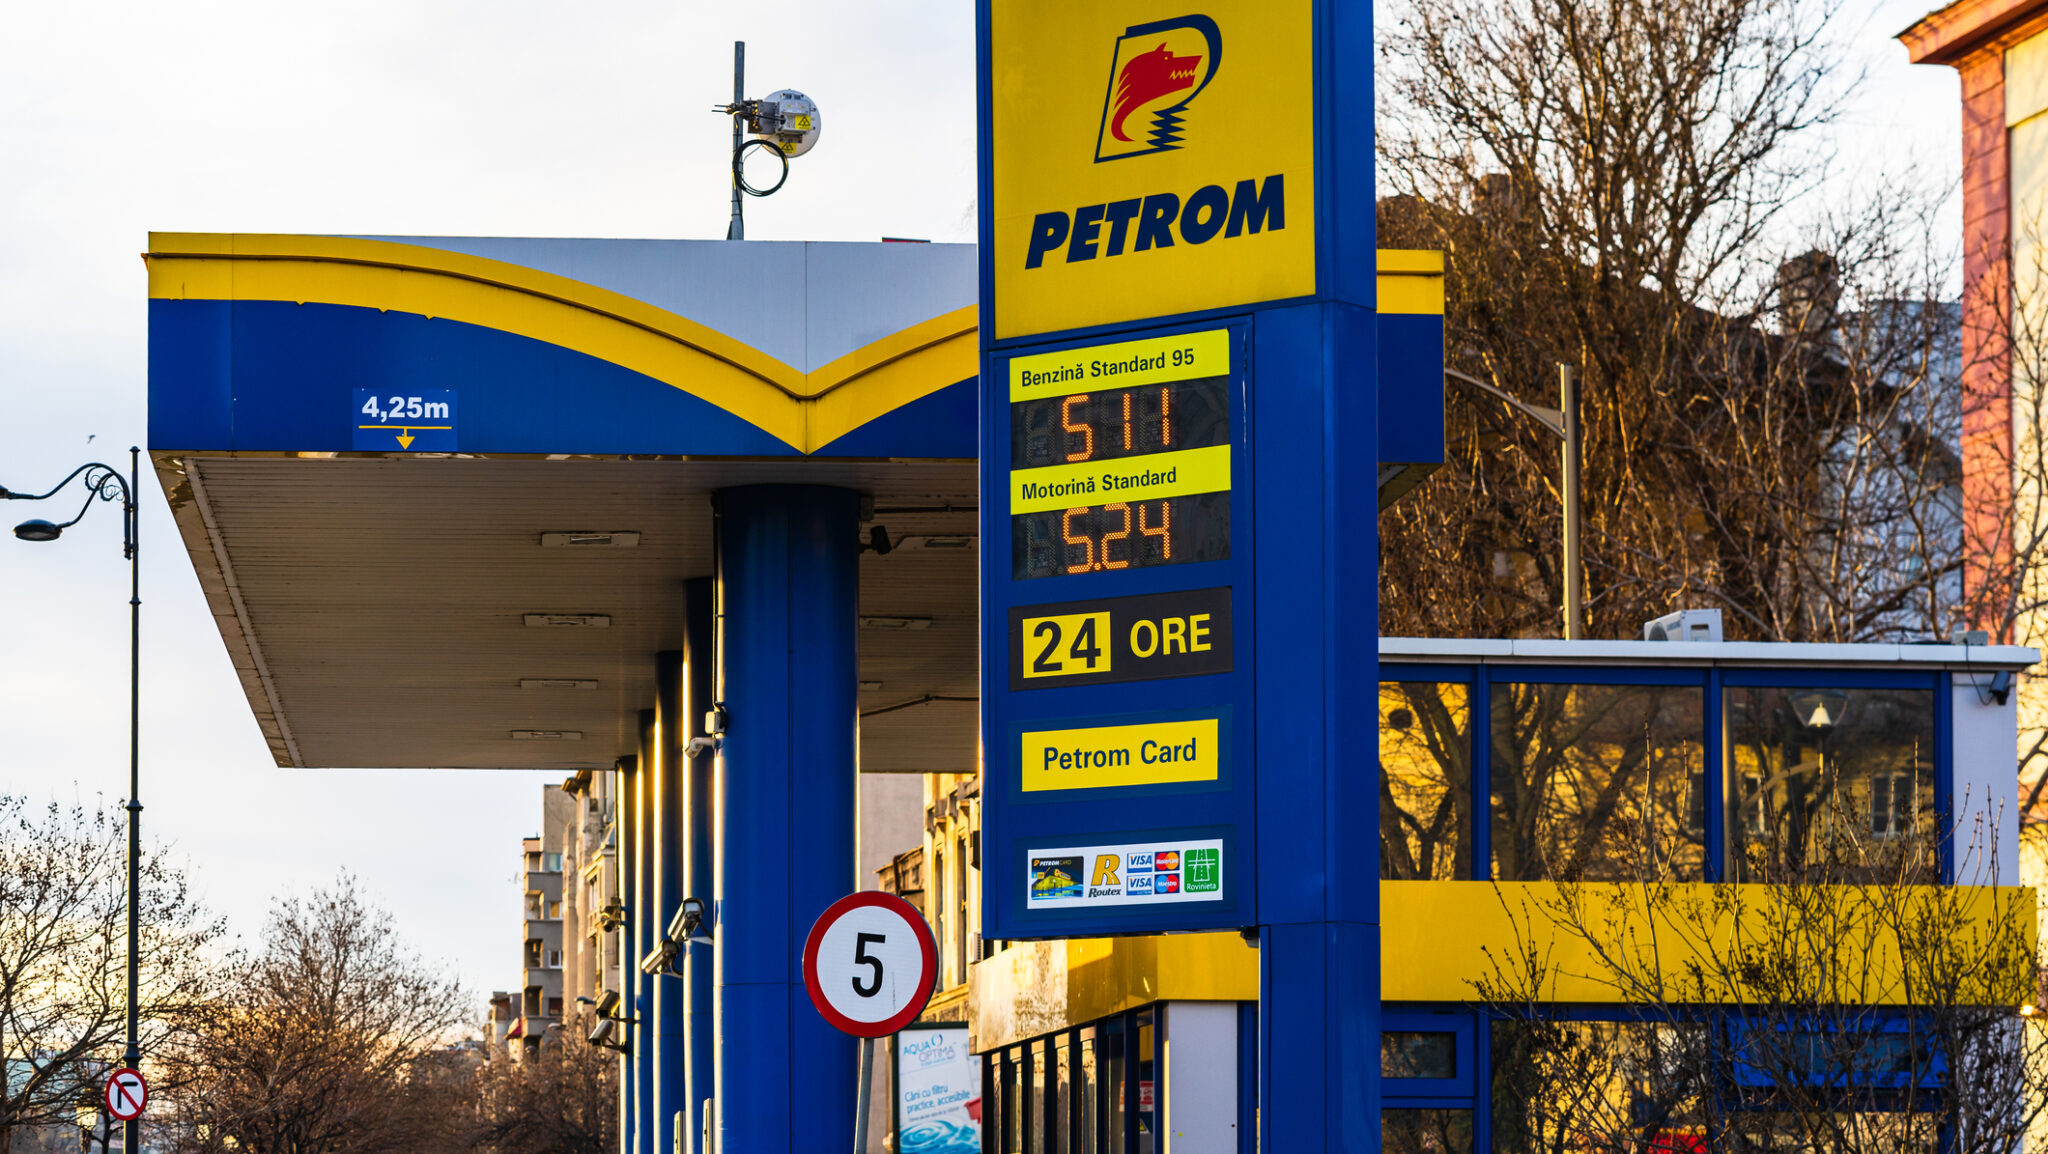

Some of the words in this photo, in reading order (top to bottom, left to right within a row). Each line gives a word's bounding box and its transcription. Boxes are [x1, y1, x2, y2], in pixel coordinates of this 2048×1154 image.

[1025, 173, 1286, 270] PETROM
[1021, 362, 1085, 388] Benzină
[1090, 351, 1166, 378] Standard
[1171, 348, 1195, 367] 95
[361, 395, 450, 423] 4,25m
[1021, 476, 1096, 501] Motorină
[1101, 466, 1177, 492] Standard
[1062, 501, 1171, 575] 5.24
[1032, 617, 1102, 674] 24
[1129, 613, 1212, 659] ORE
[1043, 746, 1131, 771] Petrom
[1140, 737, 1197, 765] Card
[1129, 854, 1152, 865] VISA
[1088, 887, 1121, 897] Routex
[1129, 876, 1152, 887] VISA
[1186, 882, 1216, 891] Rovinieta
[852, 932, 886, 998] 5
[903, 1041, 930, 1056] AQUA
[919, 1045, 955, 1061] OPTIMA
[921, 1089, 930, 1098] cu
